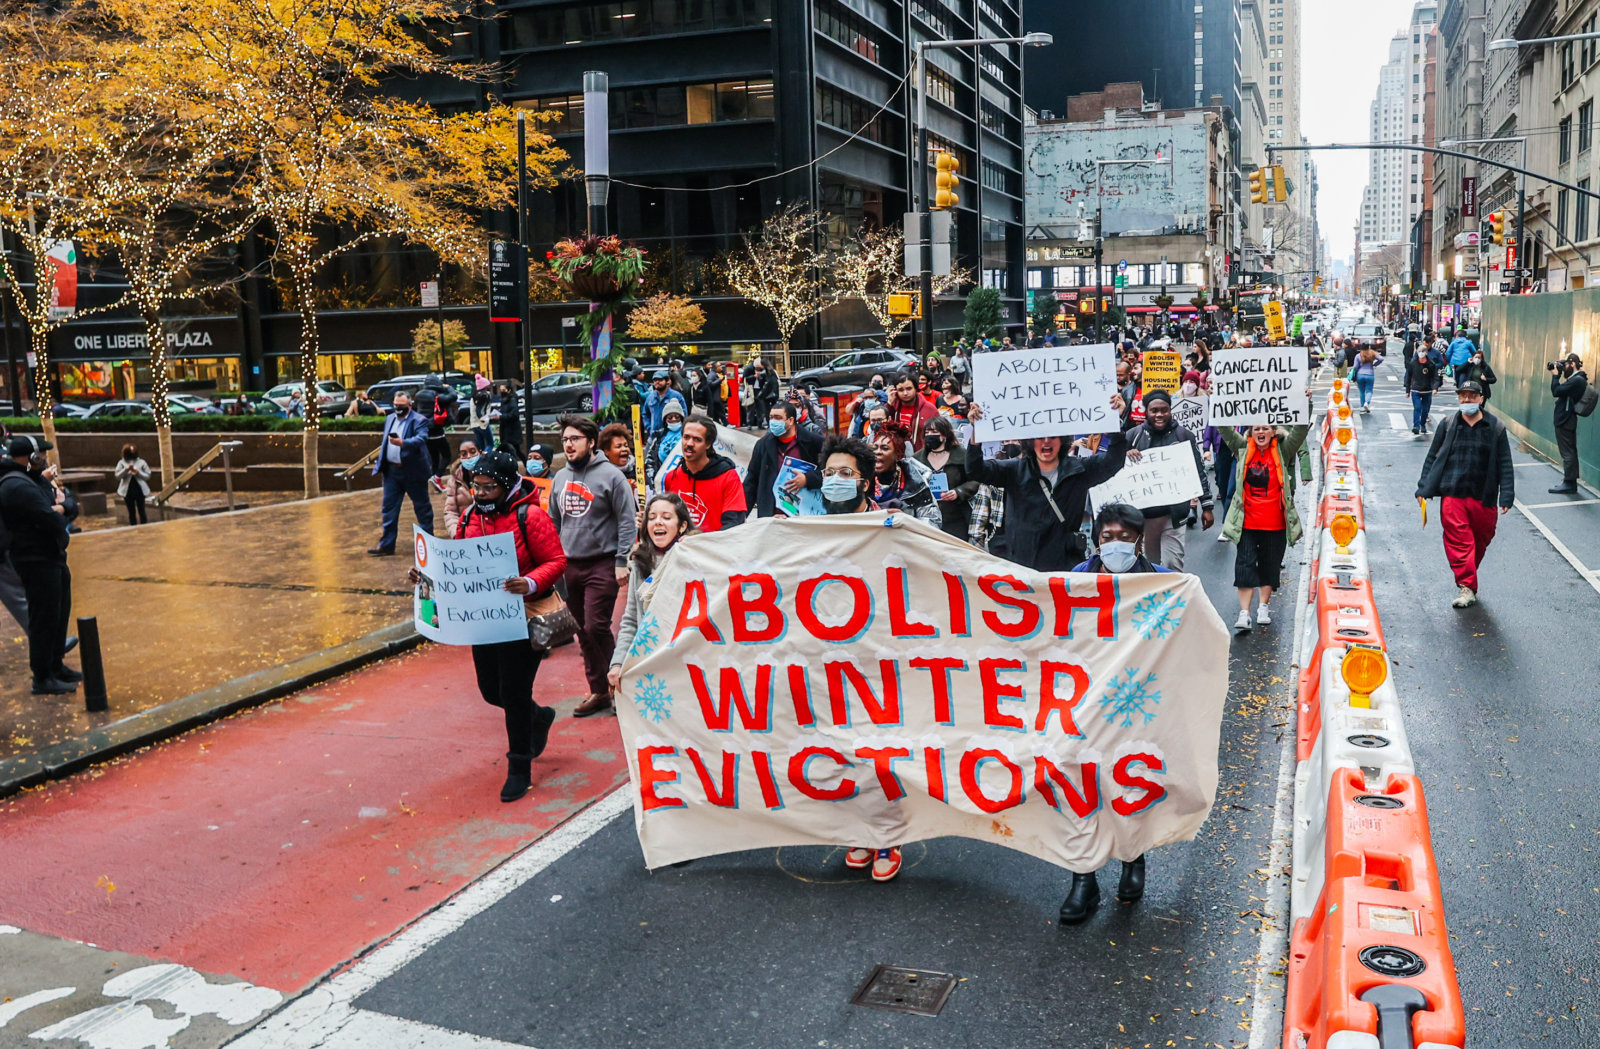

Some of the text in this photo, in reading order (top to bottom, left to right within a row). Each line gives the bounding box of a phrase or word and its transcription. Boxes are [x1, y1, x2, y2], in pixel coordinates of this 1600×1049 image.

[1062, 249, 1079, 257] Liberty
[74, 331, 213, 350] ONE LIBERT PLAZA
[997, 355, 1096, 377] ABOLISH
[1214, 356, 1298, 376] CANCEL ALL
[991, 381, 1081, 400] WINTER
[1217, 377, 1292, 396] RENT AND
[1172, 406, 1203, 421] OUSING
[1213, 396, 1289, 418] MORTGAGE
[991, 406, 1106, 431] EVICTIONS
[1267, 410, 1300, 424] DEBT
[1128, 470, 1161, 483] THE
[430, 543, 471, 561] HONOR
[438, 581, 457, 594] NO
[447, 600, 522, 622] EVICTIONS!
[668, 562, 1120, 645] ABOLISH
[684, 653, 1093, 740] WINTER
[636, 741, 1168, 820] EVICTIONS
